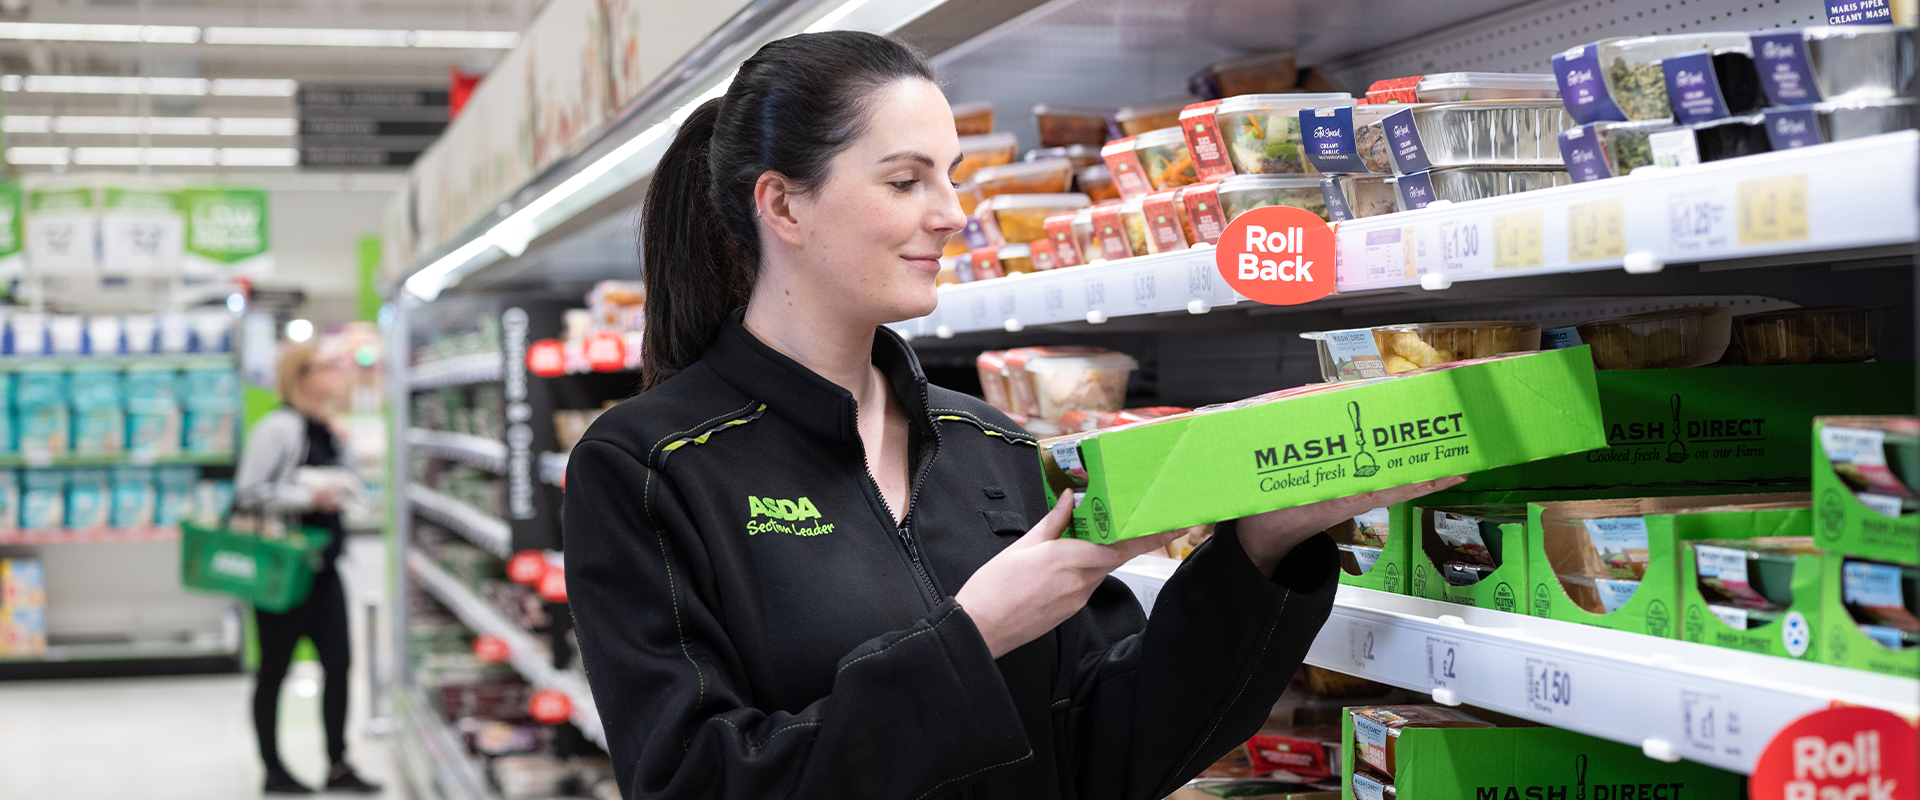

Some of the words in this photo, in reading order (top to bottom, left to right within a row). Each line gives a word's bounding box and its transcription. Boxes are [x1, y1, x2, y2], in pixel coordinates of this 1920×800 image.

[1829, 12, 1862, 25] CREAMY
[1866, 8, 1889, 19] MASH
[1831, 3, 1857, 14] MARIS
[1860, 0, 1884, 9] PIPER
[1246, 225, 1303, 253] Roll
[1448, 224, 1478, 259] £1.30
[1192, 266, 1212, 292] £3.50
[1238, 253, 1314, 282] Back
[1350, 333, 1365, 341] DIRECT
[1547, 333, 1568, 341] DIRECT
[1254, 434, 1347, 469] MASH
[1372, 412, 1463, 447] DIRECT
[1604, 422, 1665, 441] ASH
[1687, 418, 1766, 438] DIRECT
[1587, 448, 1629, 463] Cooked
[1631, 447, 1660, 465] fresh
[1695, 450, 1709, 459] on
[1713, 449, 1733, 458] our
[1735, 444, 1766, 458] Farm
[1260, 472, 1310, 492] Cooked
[1313, 464, 1346, 487] fresh
[1387, 457, 1403, 469] on
[1409, 452, 1430, 465] our
[1434, 444, 1470, 460] Farm
[748, 495, 822, 521] ASDA
[747, 518, 792, 536] Section
[792, 519, 835, 536] Leader
[1439, 522, 1454, 530] MASH
[1456, 524, 1473, 532] DIRECT
[1496, 597, 1513, 607] GLUTEN
[1363, 631, 1374, 660] £2
[1443, 647, 1456, 679] £2
[1535, 668, 1570, 706] £1.50
[1357, 720, 1369, 730] MASH
[1370, 726, 1381, 736] DIRECT
[1792, 729, 1881, 780] Roll
[1354, 779, 1366, 787] MASH
[1476, 786, 1567, 800] MASH
[1594, 783, 1684, 800] DIRECT
